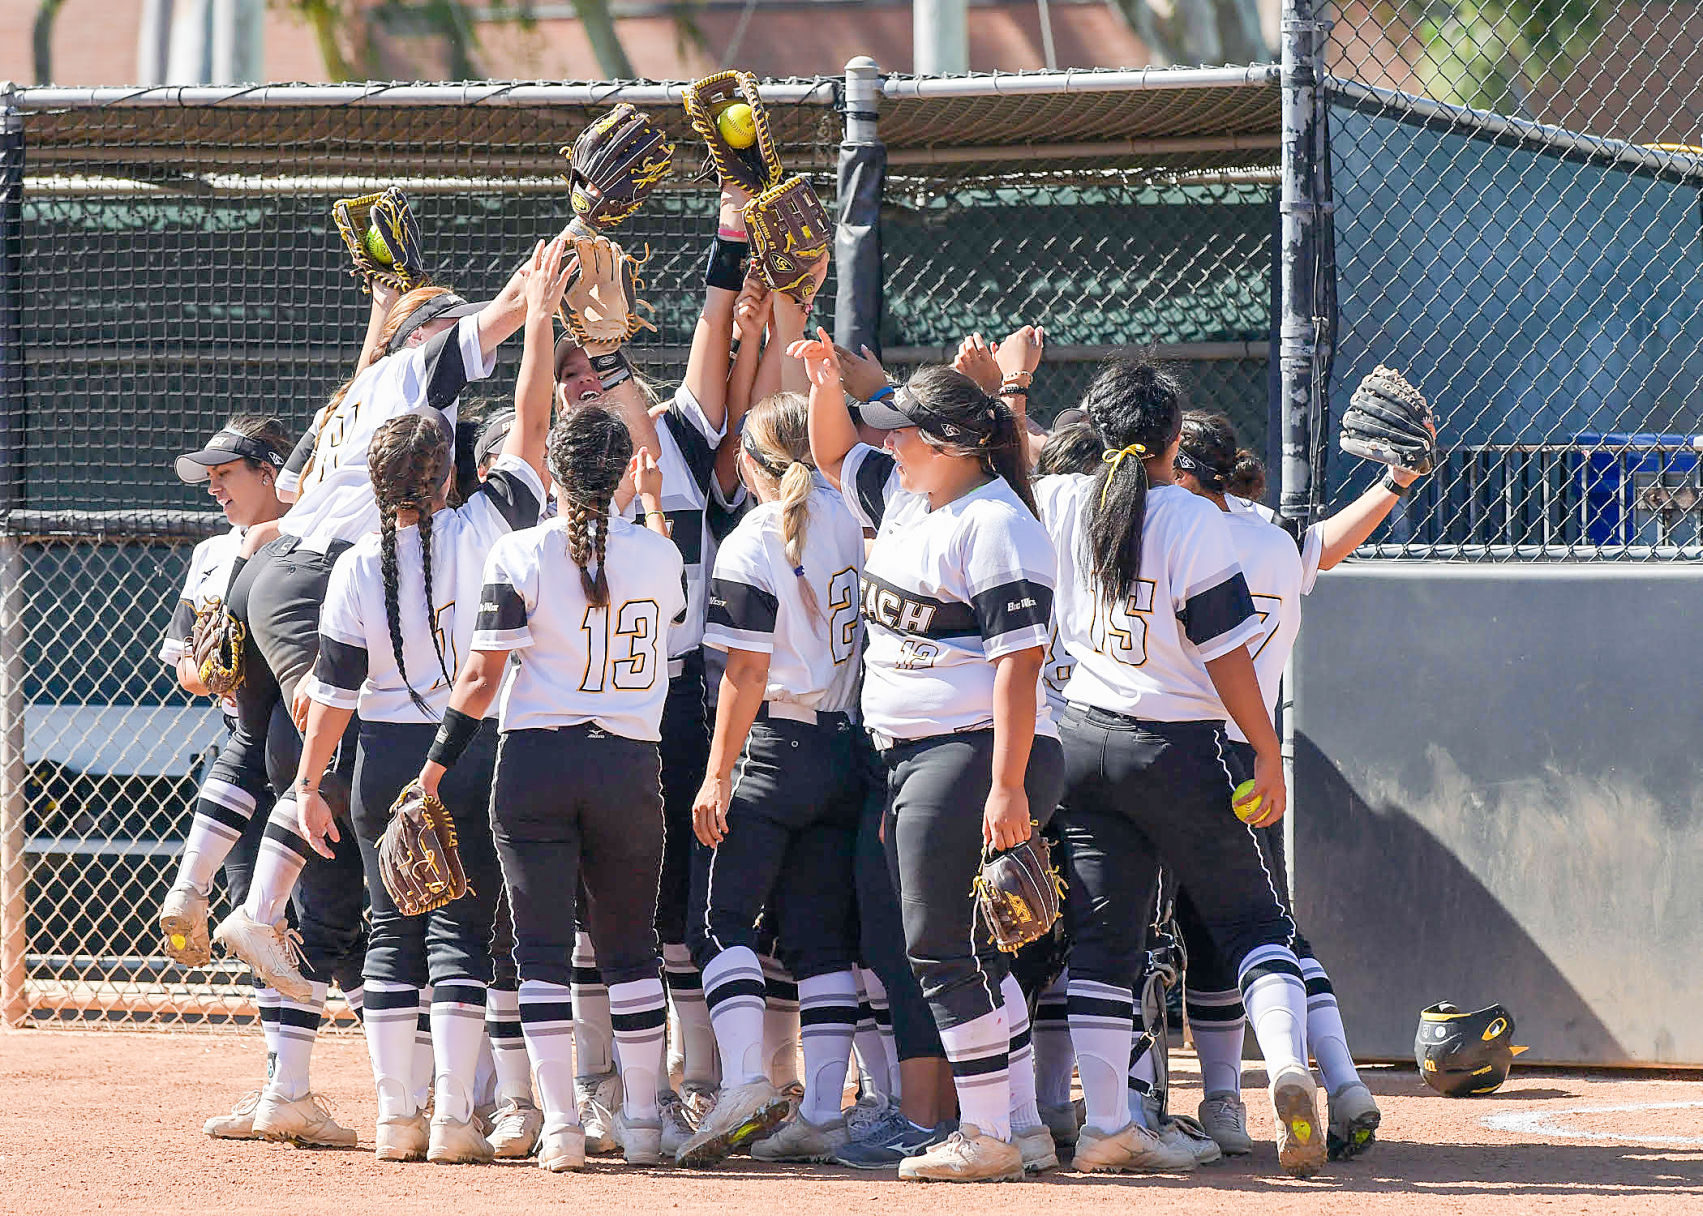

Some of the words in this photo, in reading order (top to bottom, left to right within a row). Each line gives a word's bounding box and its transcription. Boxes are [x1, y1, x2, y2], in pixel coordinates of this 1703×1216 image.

[1381, 382, 1421, 411] LOUISVILLE
[576, 598, 661, 694] 13
[828, 566, 860, 666] 2
[1089, 570, 1158, 668] 15
